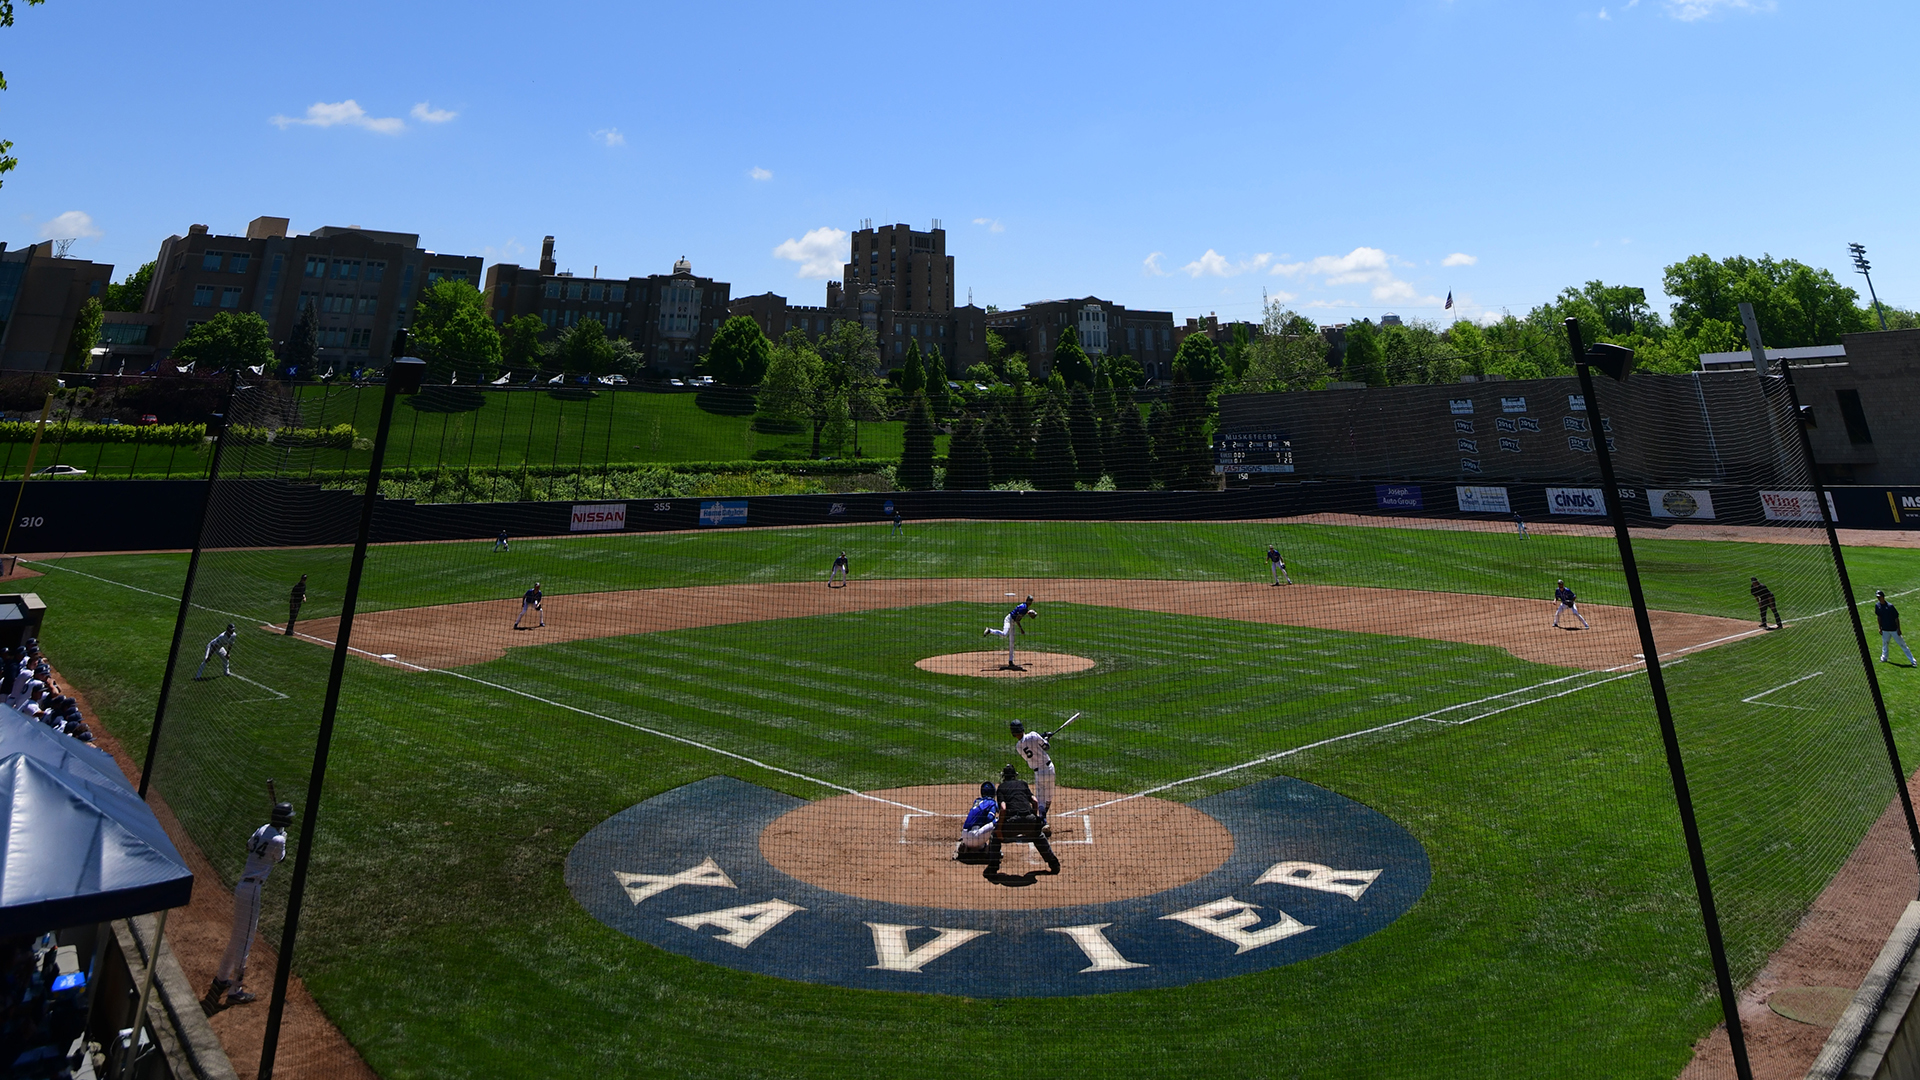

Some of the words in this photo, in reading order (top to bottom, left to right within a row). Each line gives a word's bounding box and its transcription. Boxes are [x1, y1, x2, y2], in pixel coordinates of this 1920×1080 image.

[289, 367, 297, 375] X
[355, 369, 361, 377] X
[1388, 488, 1408, 497] Joseph
[653, 503, 671, 512] 355
[1383, 497, 1398, 505] Auto
[1397, 497, 1418, 506] Group
[1762, 494, 1800, 510] Wing
[19, 516, 44, 529] 310
[572, 511, 625, 523] NISSAN
[1023, 747, 1033, 759] 5
[249, 835, 269, 860] 34
[613, 855, 1383, 974] XAVIER
